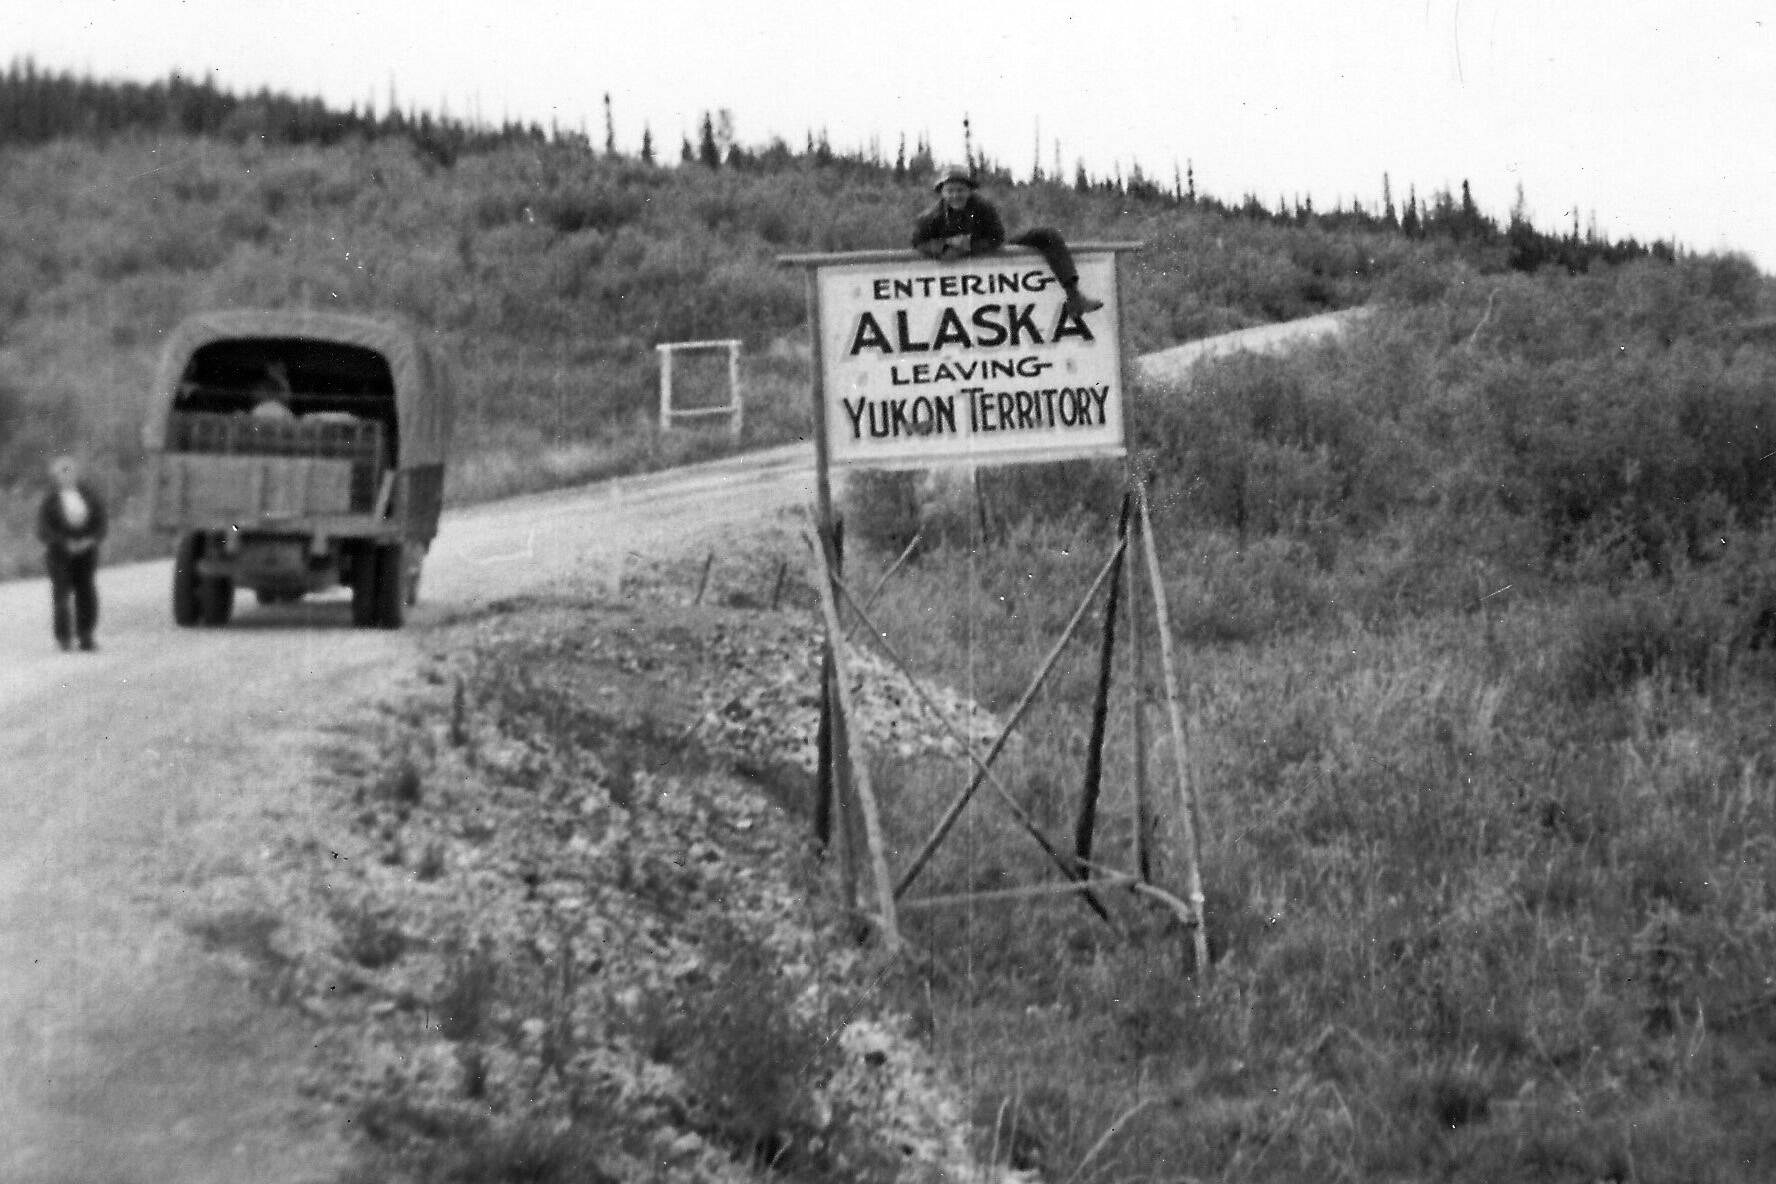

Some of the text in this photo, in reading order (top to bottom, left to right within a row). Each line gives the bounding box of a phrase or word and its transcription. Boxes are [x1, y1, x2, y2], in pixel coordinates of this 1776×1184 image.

[873, 270, 1055, 300] ENTERING
[850, 301, 1094, 355] ALASKA
[891, 356, 1052, 385] LEAVING
[843, 386, 1109, 438] YUKON TERRITORY
